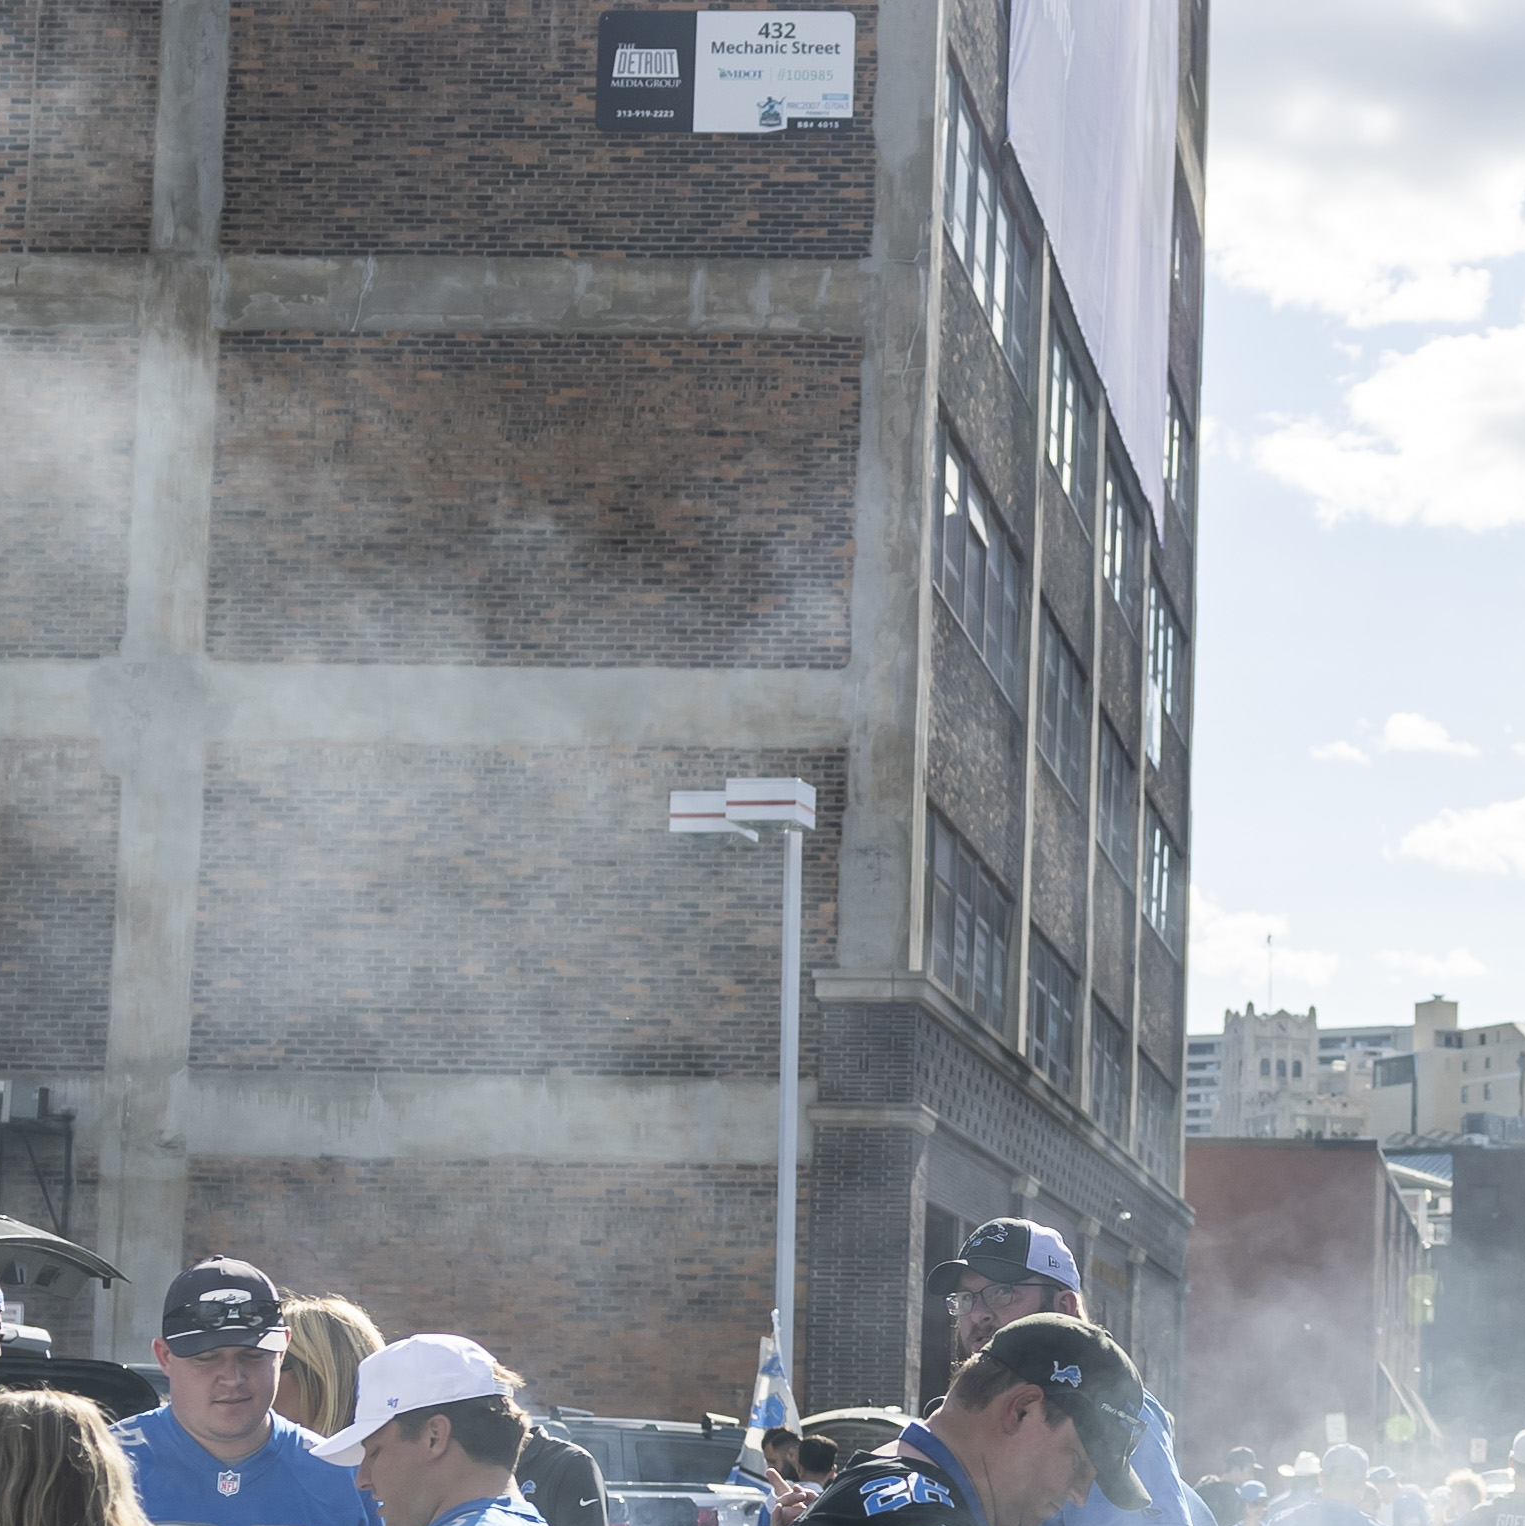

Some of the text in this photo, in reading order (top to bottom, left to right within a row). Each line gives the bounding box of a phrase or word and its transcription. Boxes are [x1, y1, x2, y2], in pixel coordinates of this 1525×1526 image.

[758, 22, 797, 39] 432
[710, 41, 841, 55] Mechanic Street
[617, 51, 676, 75] DETROIT
[610, 79, 682, 88] MEDIA GROUP
[220, 1481, 238, 1493] NFL
